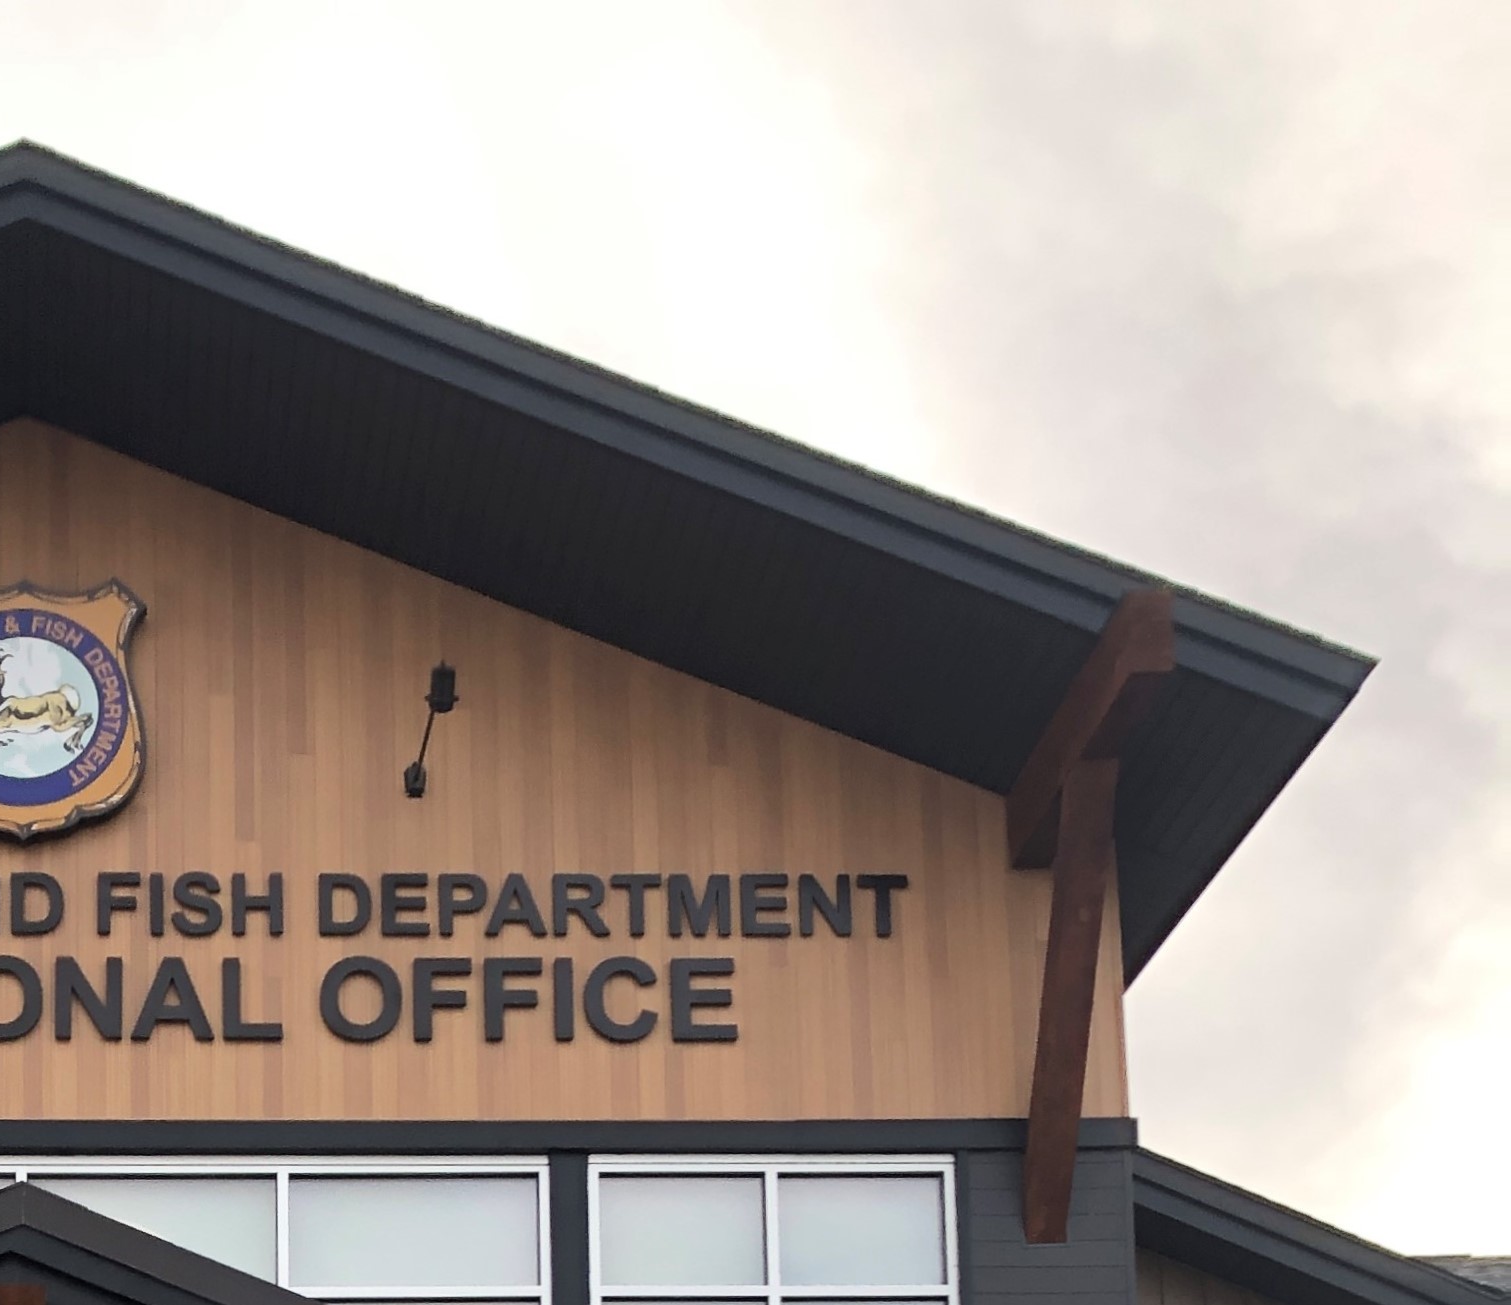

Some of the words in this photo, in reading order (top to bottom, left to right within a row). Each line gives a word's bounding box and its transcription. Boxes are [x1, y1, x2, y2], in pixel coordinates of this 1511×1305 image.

[5, 615, 21, 634] &
[31, 616, 83, 648] FISH
[69, 649, 122, 786] DEPARTMENT
[95, 871, 285, 939] FISH
[318, 872, 910, 939] DEPARTMENT
[319, 955, 740, 1045] OFFICE
